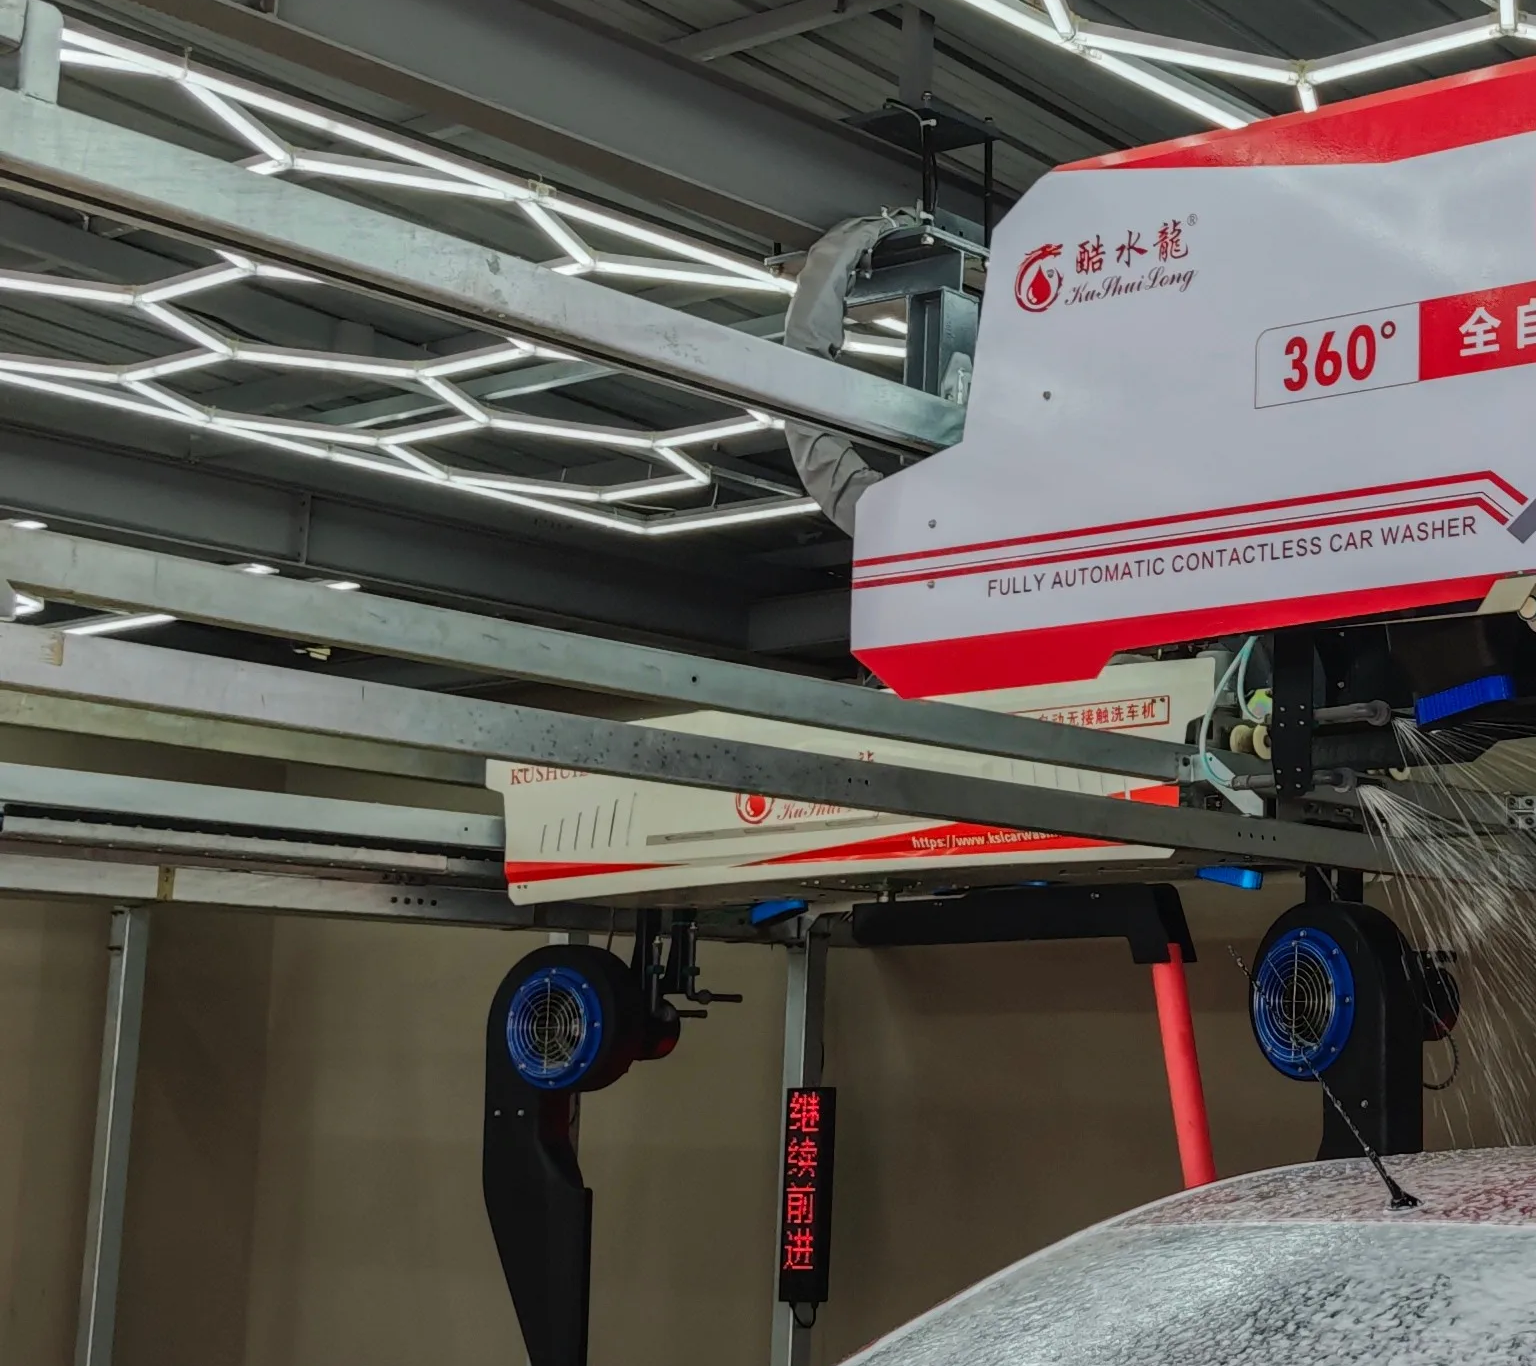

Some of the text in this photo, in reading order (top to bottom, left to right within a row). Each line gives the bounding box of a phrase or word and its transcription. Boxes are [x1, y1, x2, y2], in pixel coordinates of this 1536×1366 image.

[1283, 320, 1397, 393] 360°
[987, 515, 1477, 597] FULLY AUTOMATIC CONTACTLESS CAR WASHER
[783, 1091, 821, 1270] 继续前进
